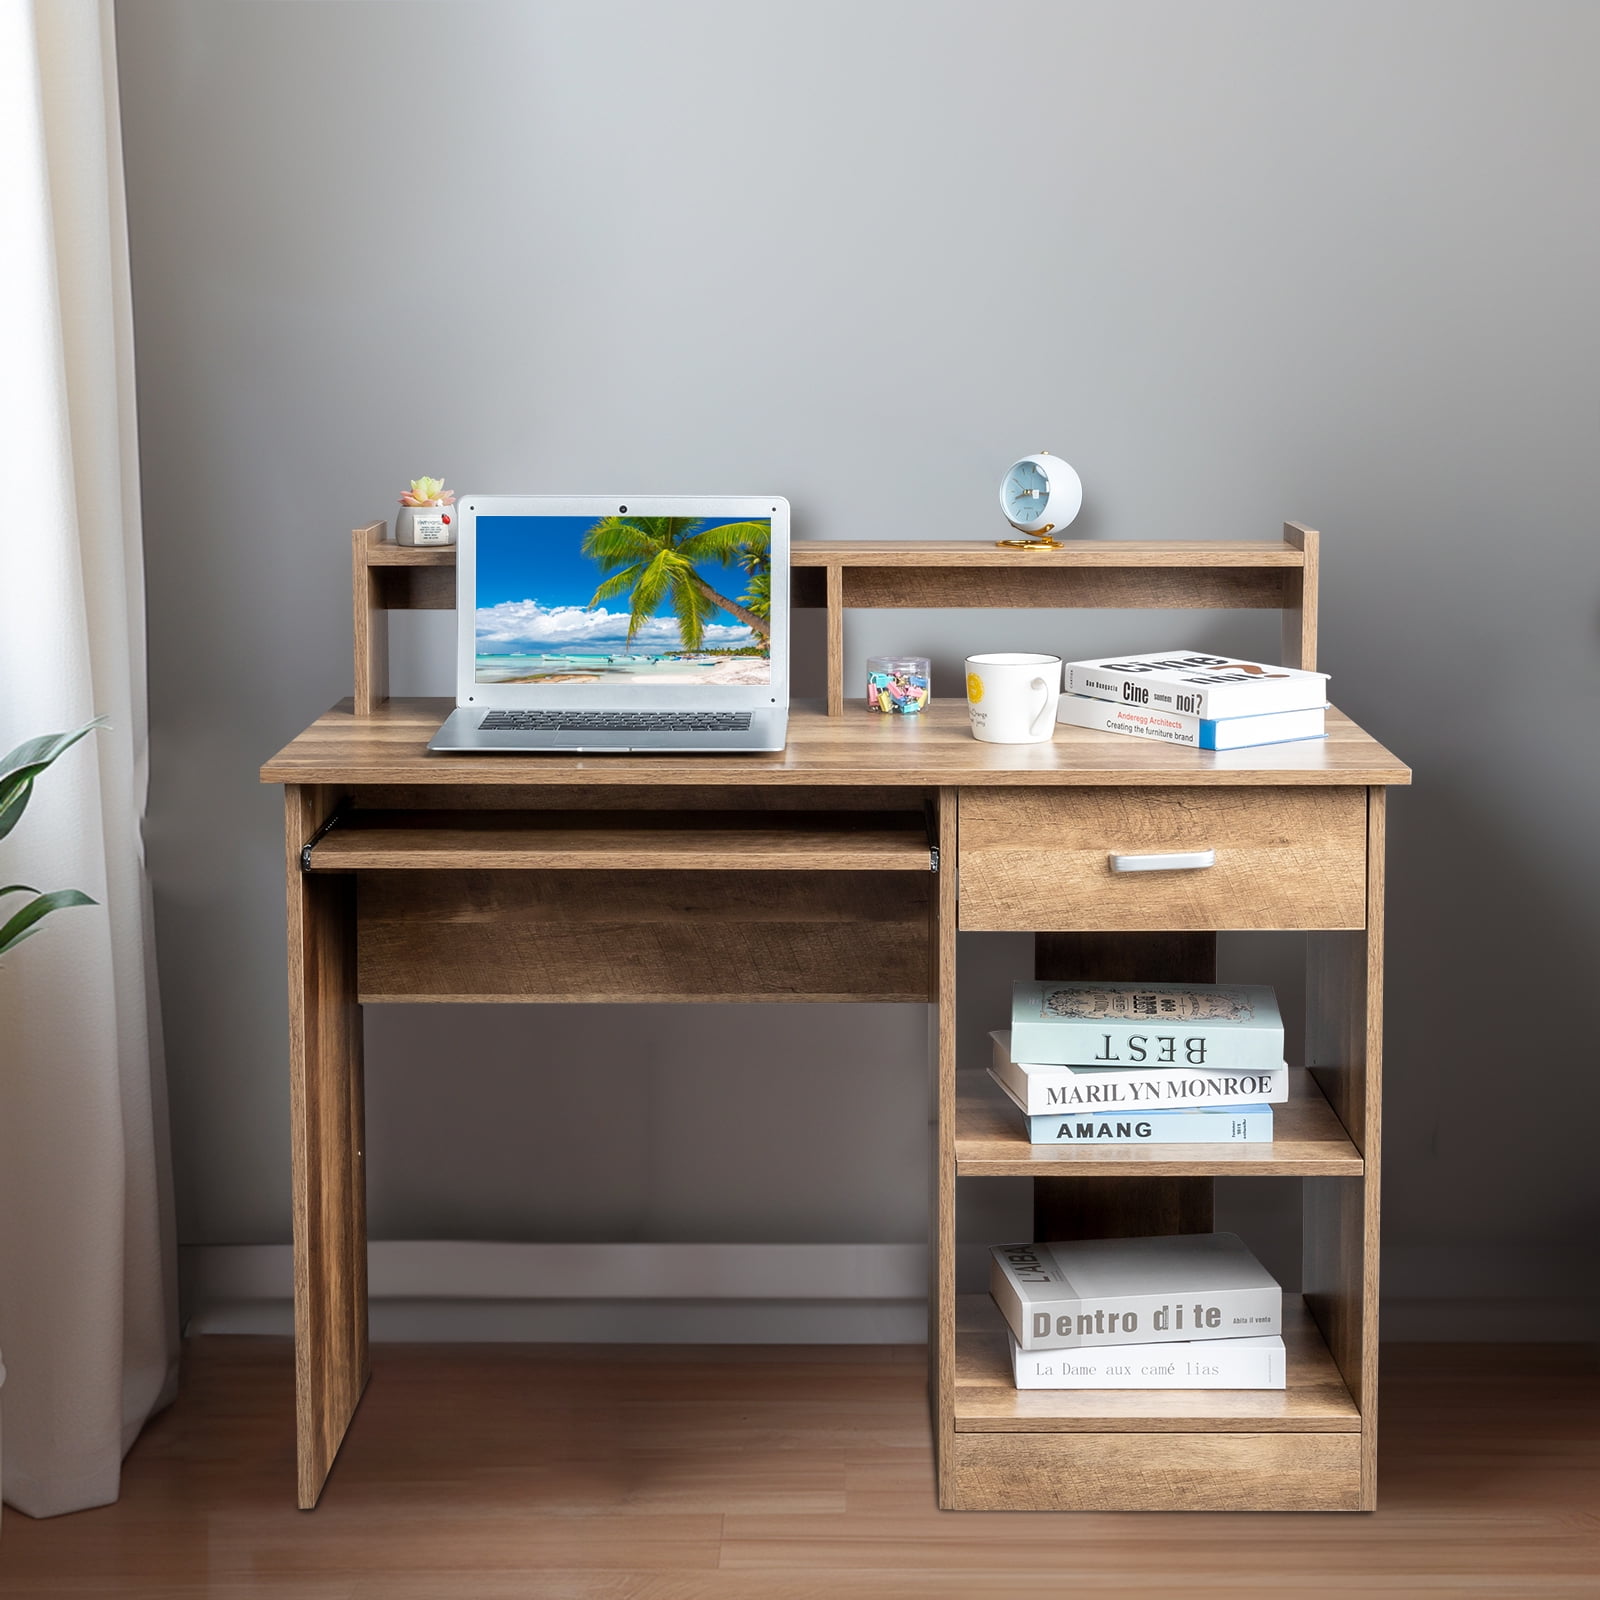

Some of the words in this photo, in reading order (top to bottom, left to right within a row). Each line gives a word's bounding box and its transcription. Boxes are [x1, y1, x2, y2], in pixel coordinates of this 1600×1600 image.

[1099, 656, 1229, 673] Cine
[1122, 681, 1149, 704] Cine
[1176, 694, 1203, 715] noi?
[1106, 720, 1133, 733] Creating
[1134, 725, 1144, 733] the
[1145, 727, 1173, 738] furniture
[1174, 732, 1194, 742] brand
[1117, 711, 1148, 725] Anderegg
[1149, 717, 1182, 729] Architects
[1095, 1034, 1208, 1064] BEST
[1046, 1081, 1160, 1105] MARILYN
[1167, 1075, 1273, 1098] MONROE
[1056, 1122, 1152, 1138] AMANG
[1033, 1309, 1138, 1338] Dentro
[1193, 1304, 1222, 1329] te
[1035, 1362, 1053, 1376] La
[1062, 1362, 1097, 1376] Dame
[1105, 1365, 1132, 1376] aux
